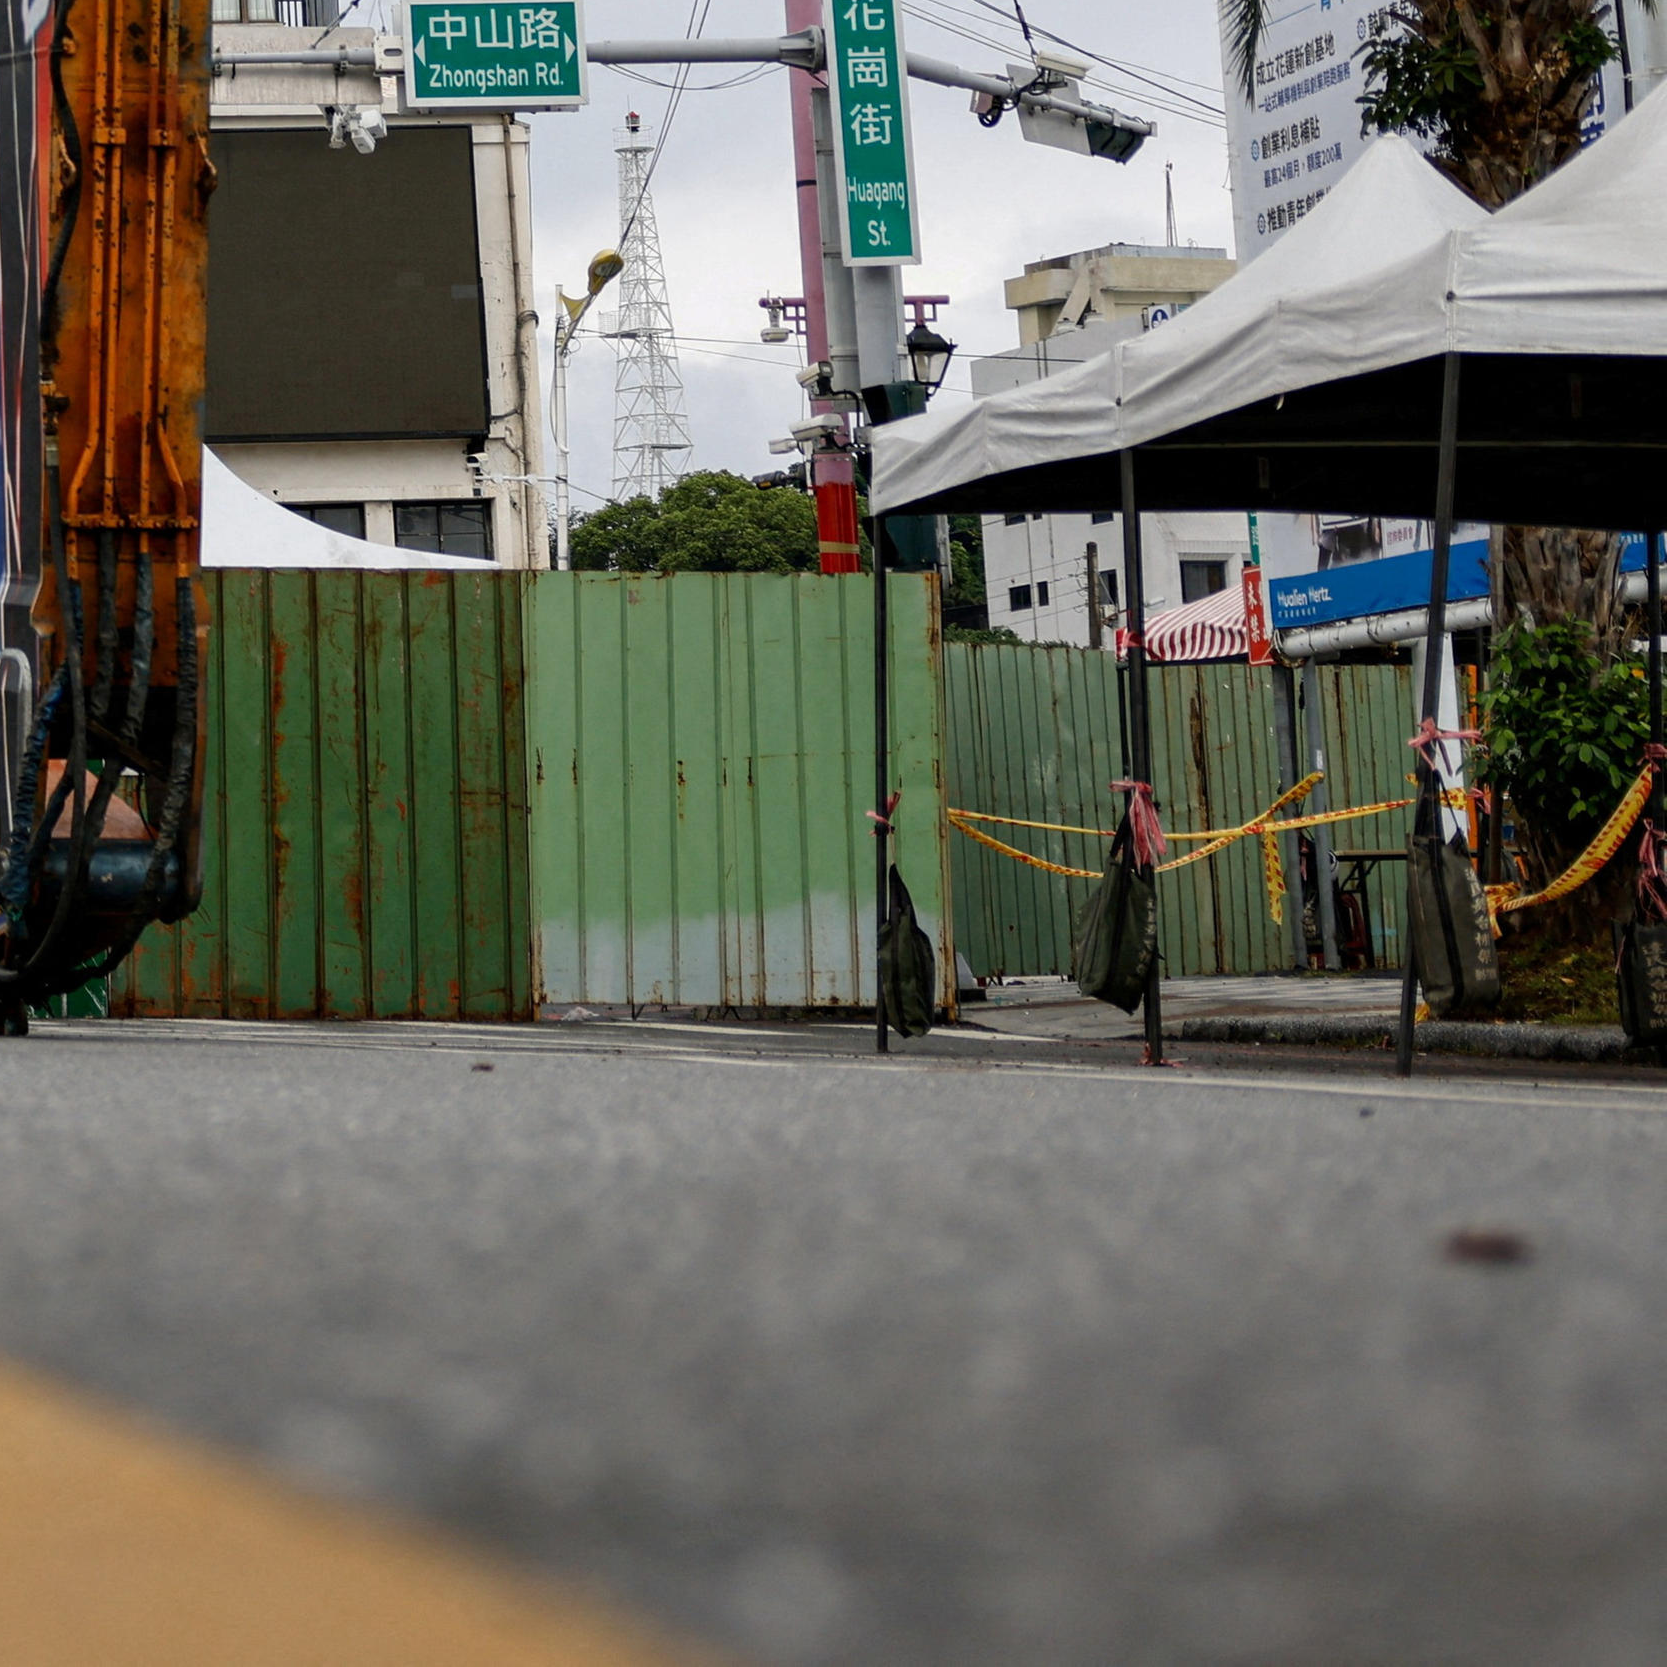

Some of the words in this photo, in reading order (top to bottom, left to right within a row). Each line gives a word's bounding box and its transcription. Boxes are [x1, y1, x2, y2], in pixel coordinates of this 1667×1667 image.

[428, 7, 562, 52] 中山路
[428, 62, 529, 93] Zhongshan
[534, 63, 565, 86] Rd.
[847, 176, 906, 210] Huagang
[1267, 185, 1332, 234] 推動青年創
[867, 221, 892, 247] St.
[1277, 589, 1308, 608] Hualien
